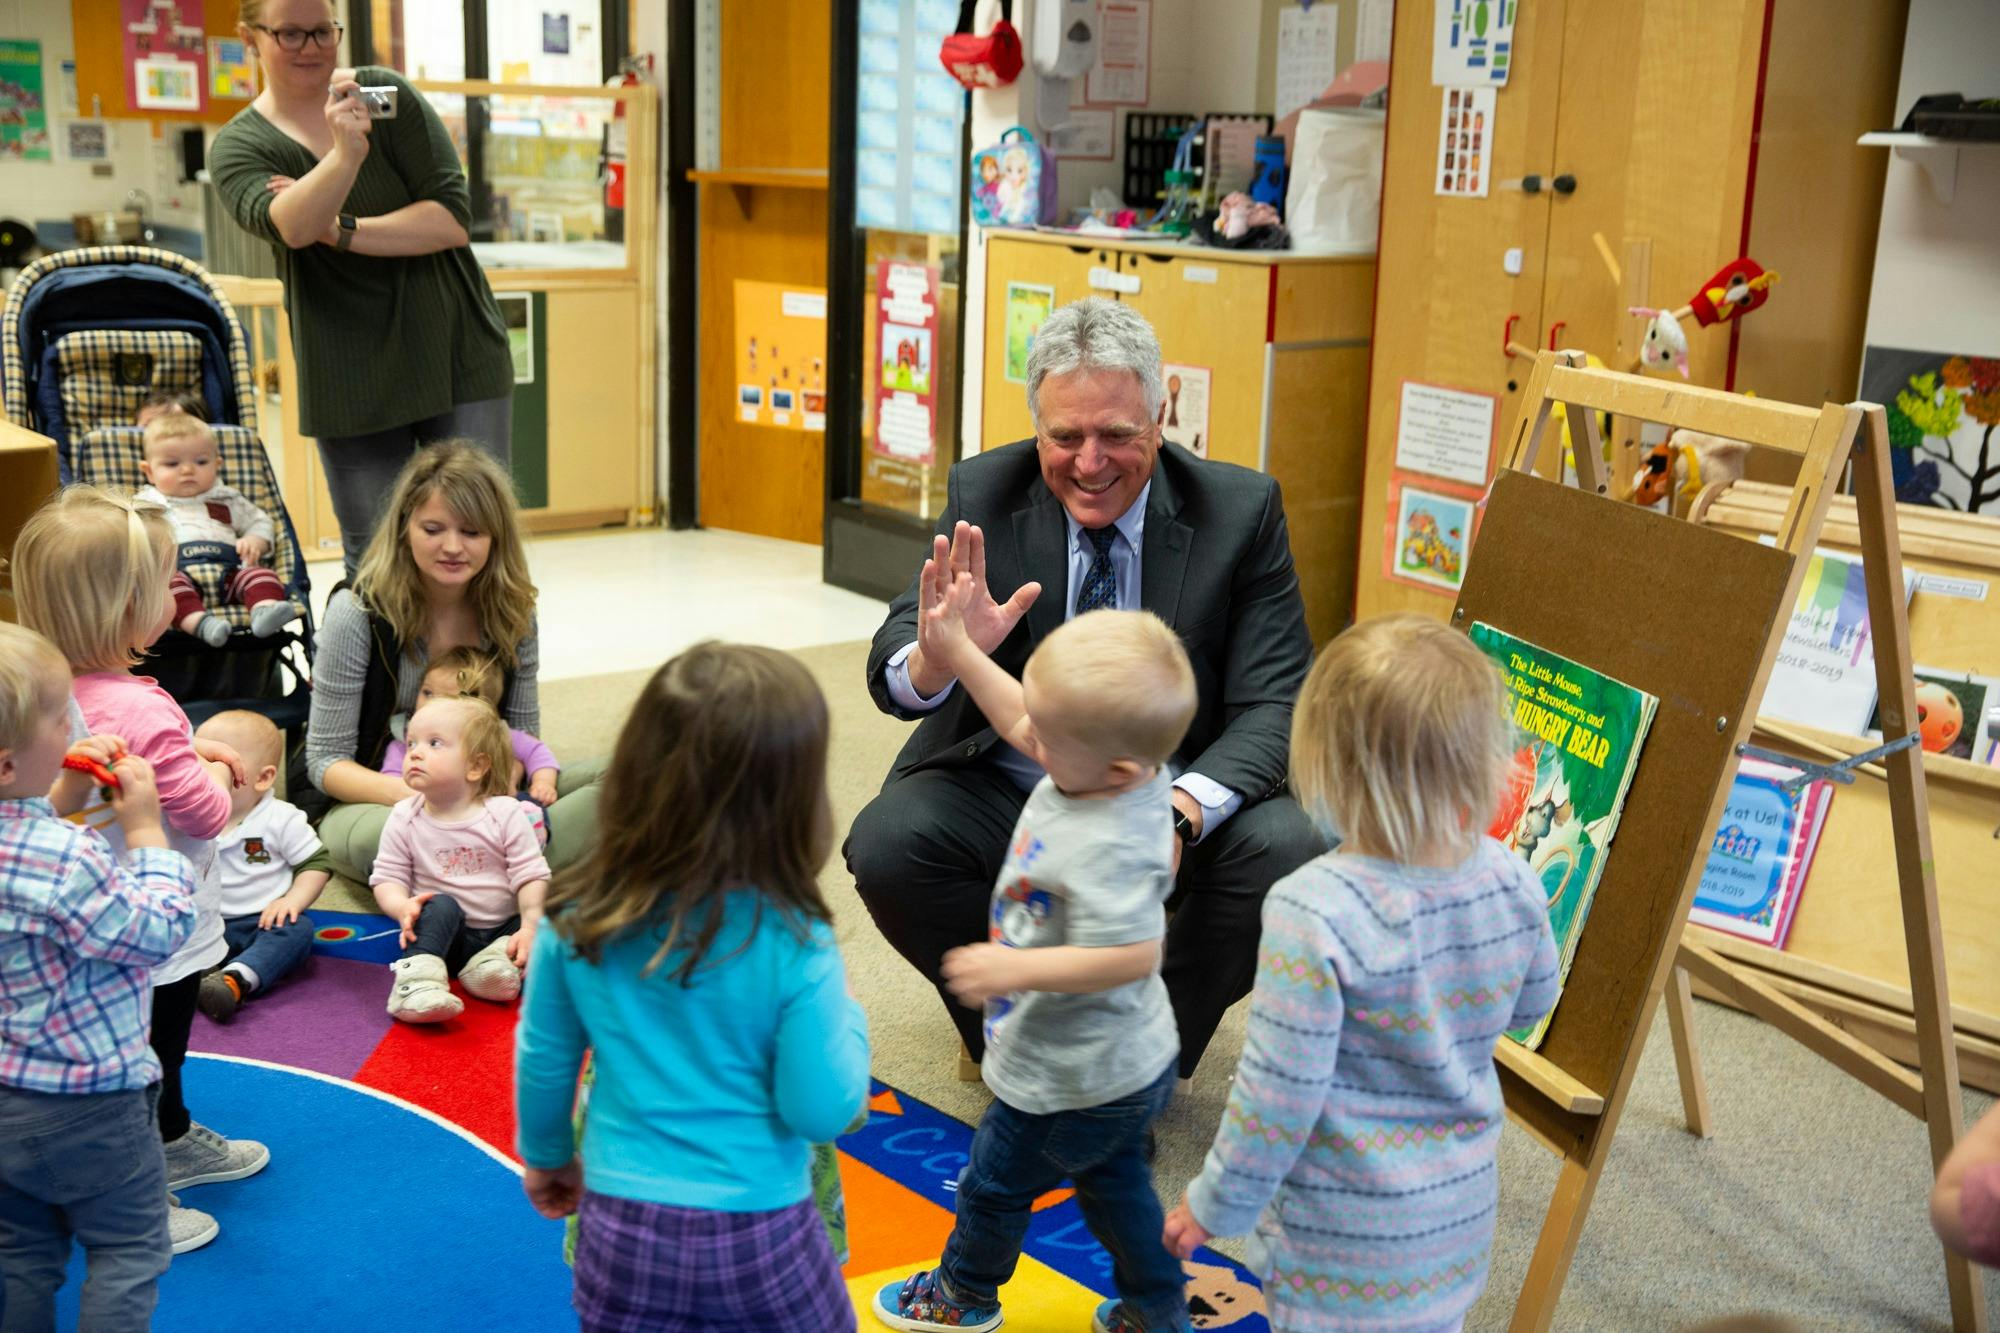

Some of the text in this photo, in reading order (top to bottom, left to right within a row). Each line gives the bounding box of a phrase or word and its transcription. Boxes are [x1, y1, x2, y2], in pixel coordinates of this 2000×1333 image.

[1793, 614, 1829, 629] agine
[1510, 653, 1582, 699] The Little Mouse,
[1514, 676, 1535, 697] Ripe
[1536, 686, 1586, 723] Strawberry,
[1587, 713, 1605, 729] and
[1514, 698, 1572, 748] HUNGRY
[1567, 724, 1610, 769] BEAR
[1701, 879, 1745, 897] 018-2019
